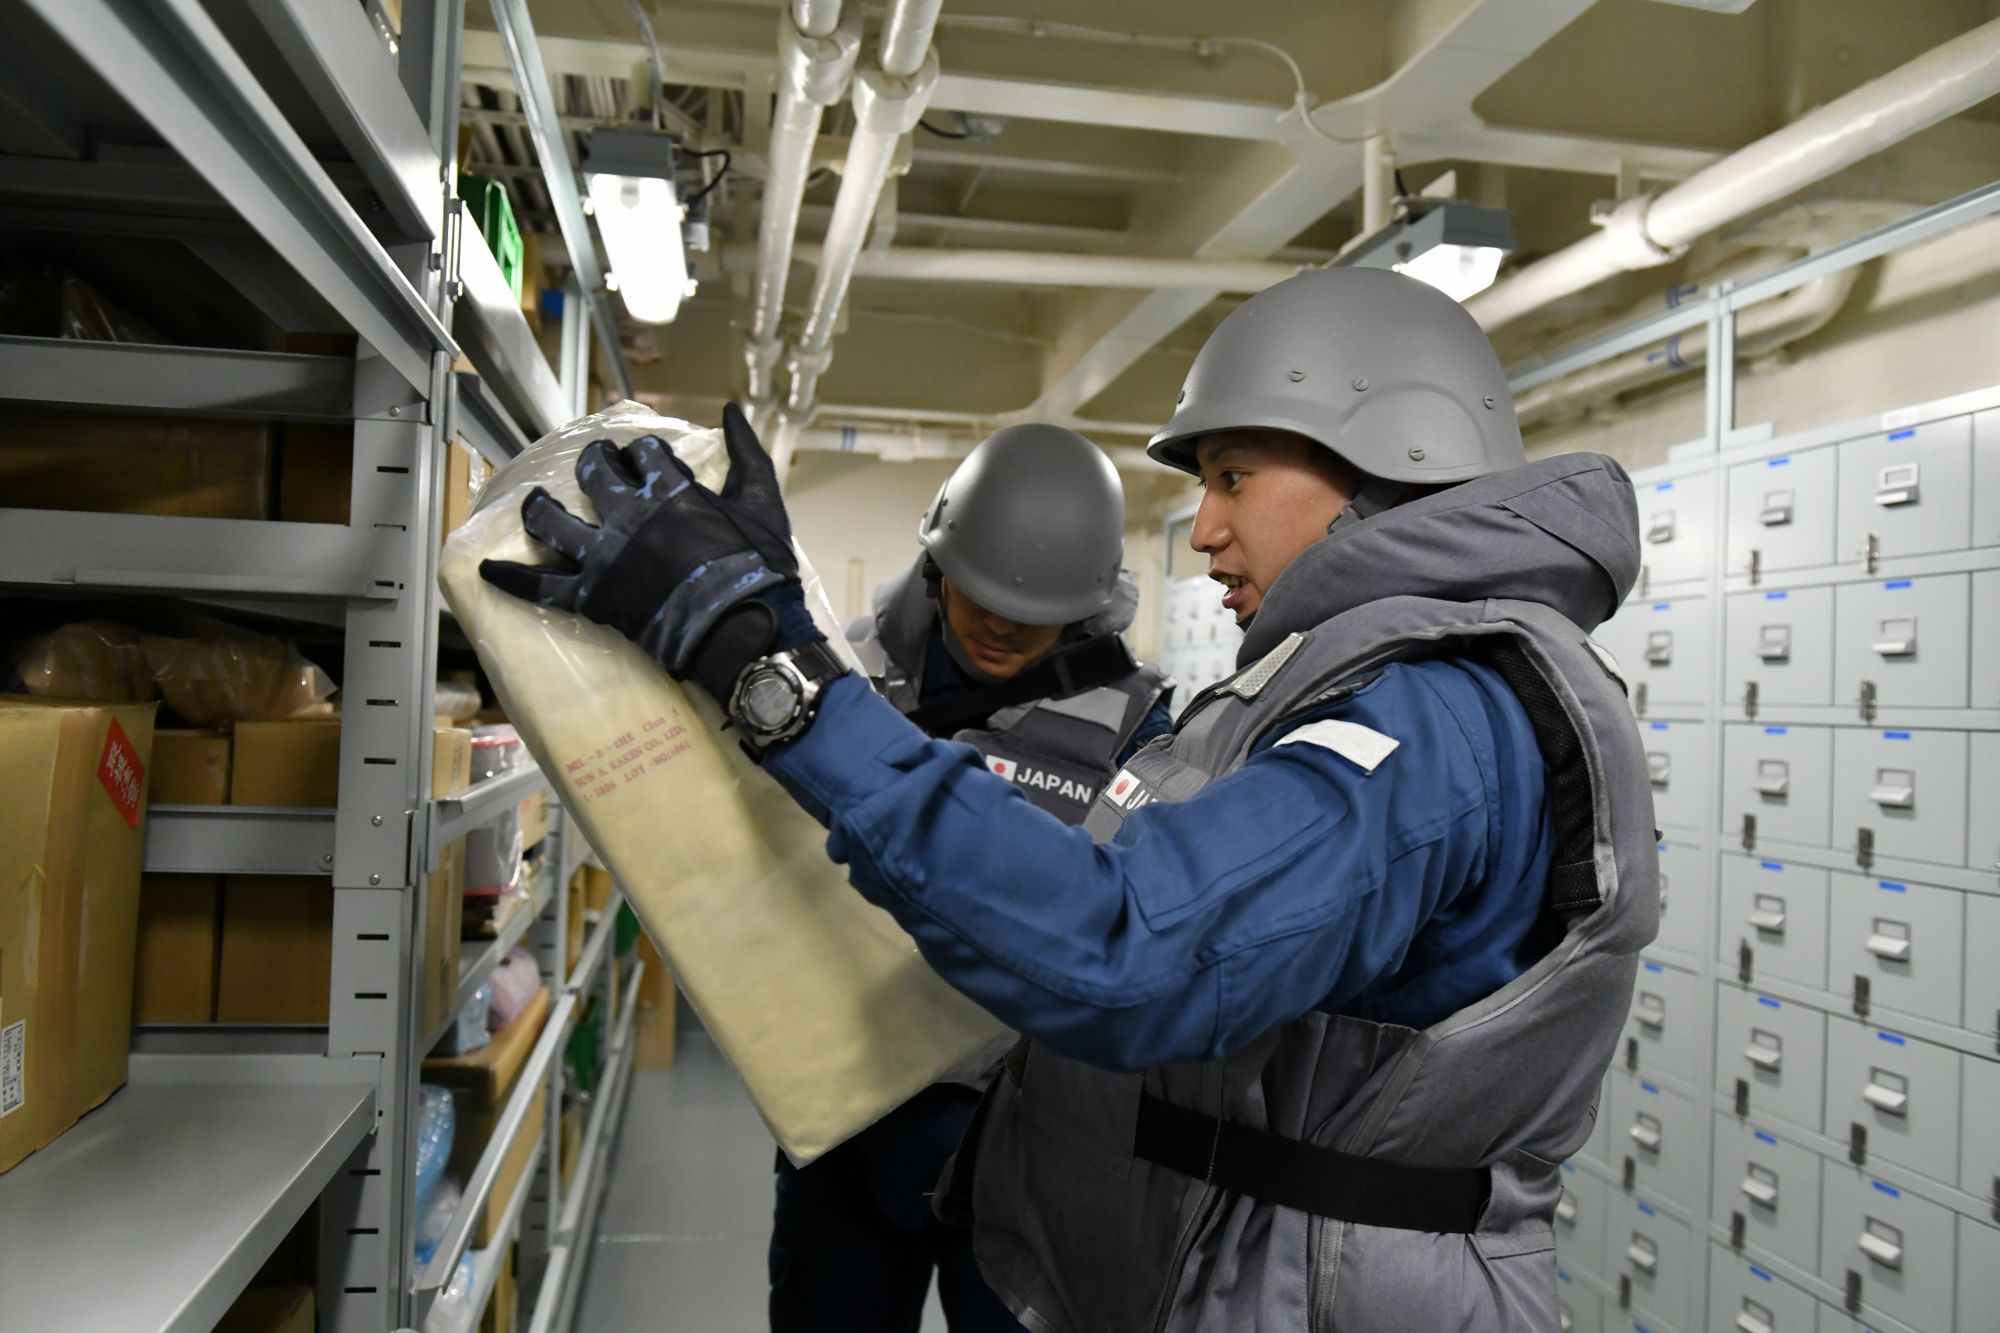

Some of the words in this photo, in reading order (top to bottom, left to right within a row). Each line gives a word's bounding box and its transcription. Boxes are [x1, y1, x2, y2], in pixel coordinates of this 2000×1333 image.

[624, 764, 645, 782] LOT
[1016, 767, 1092, 804] JAPAN
[1126, 789, 1158, 810] JA
